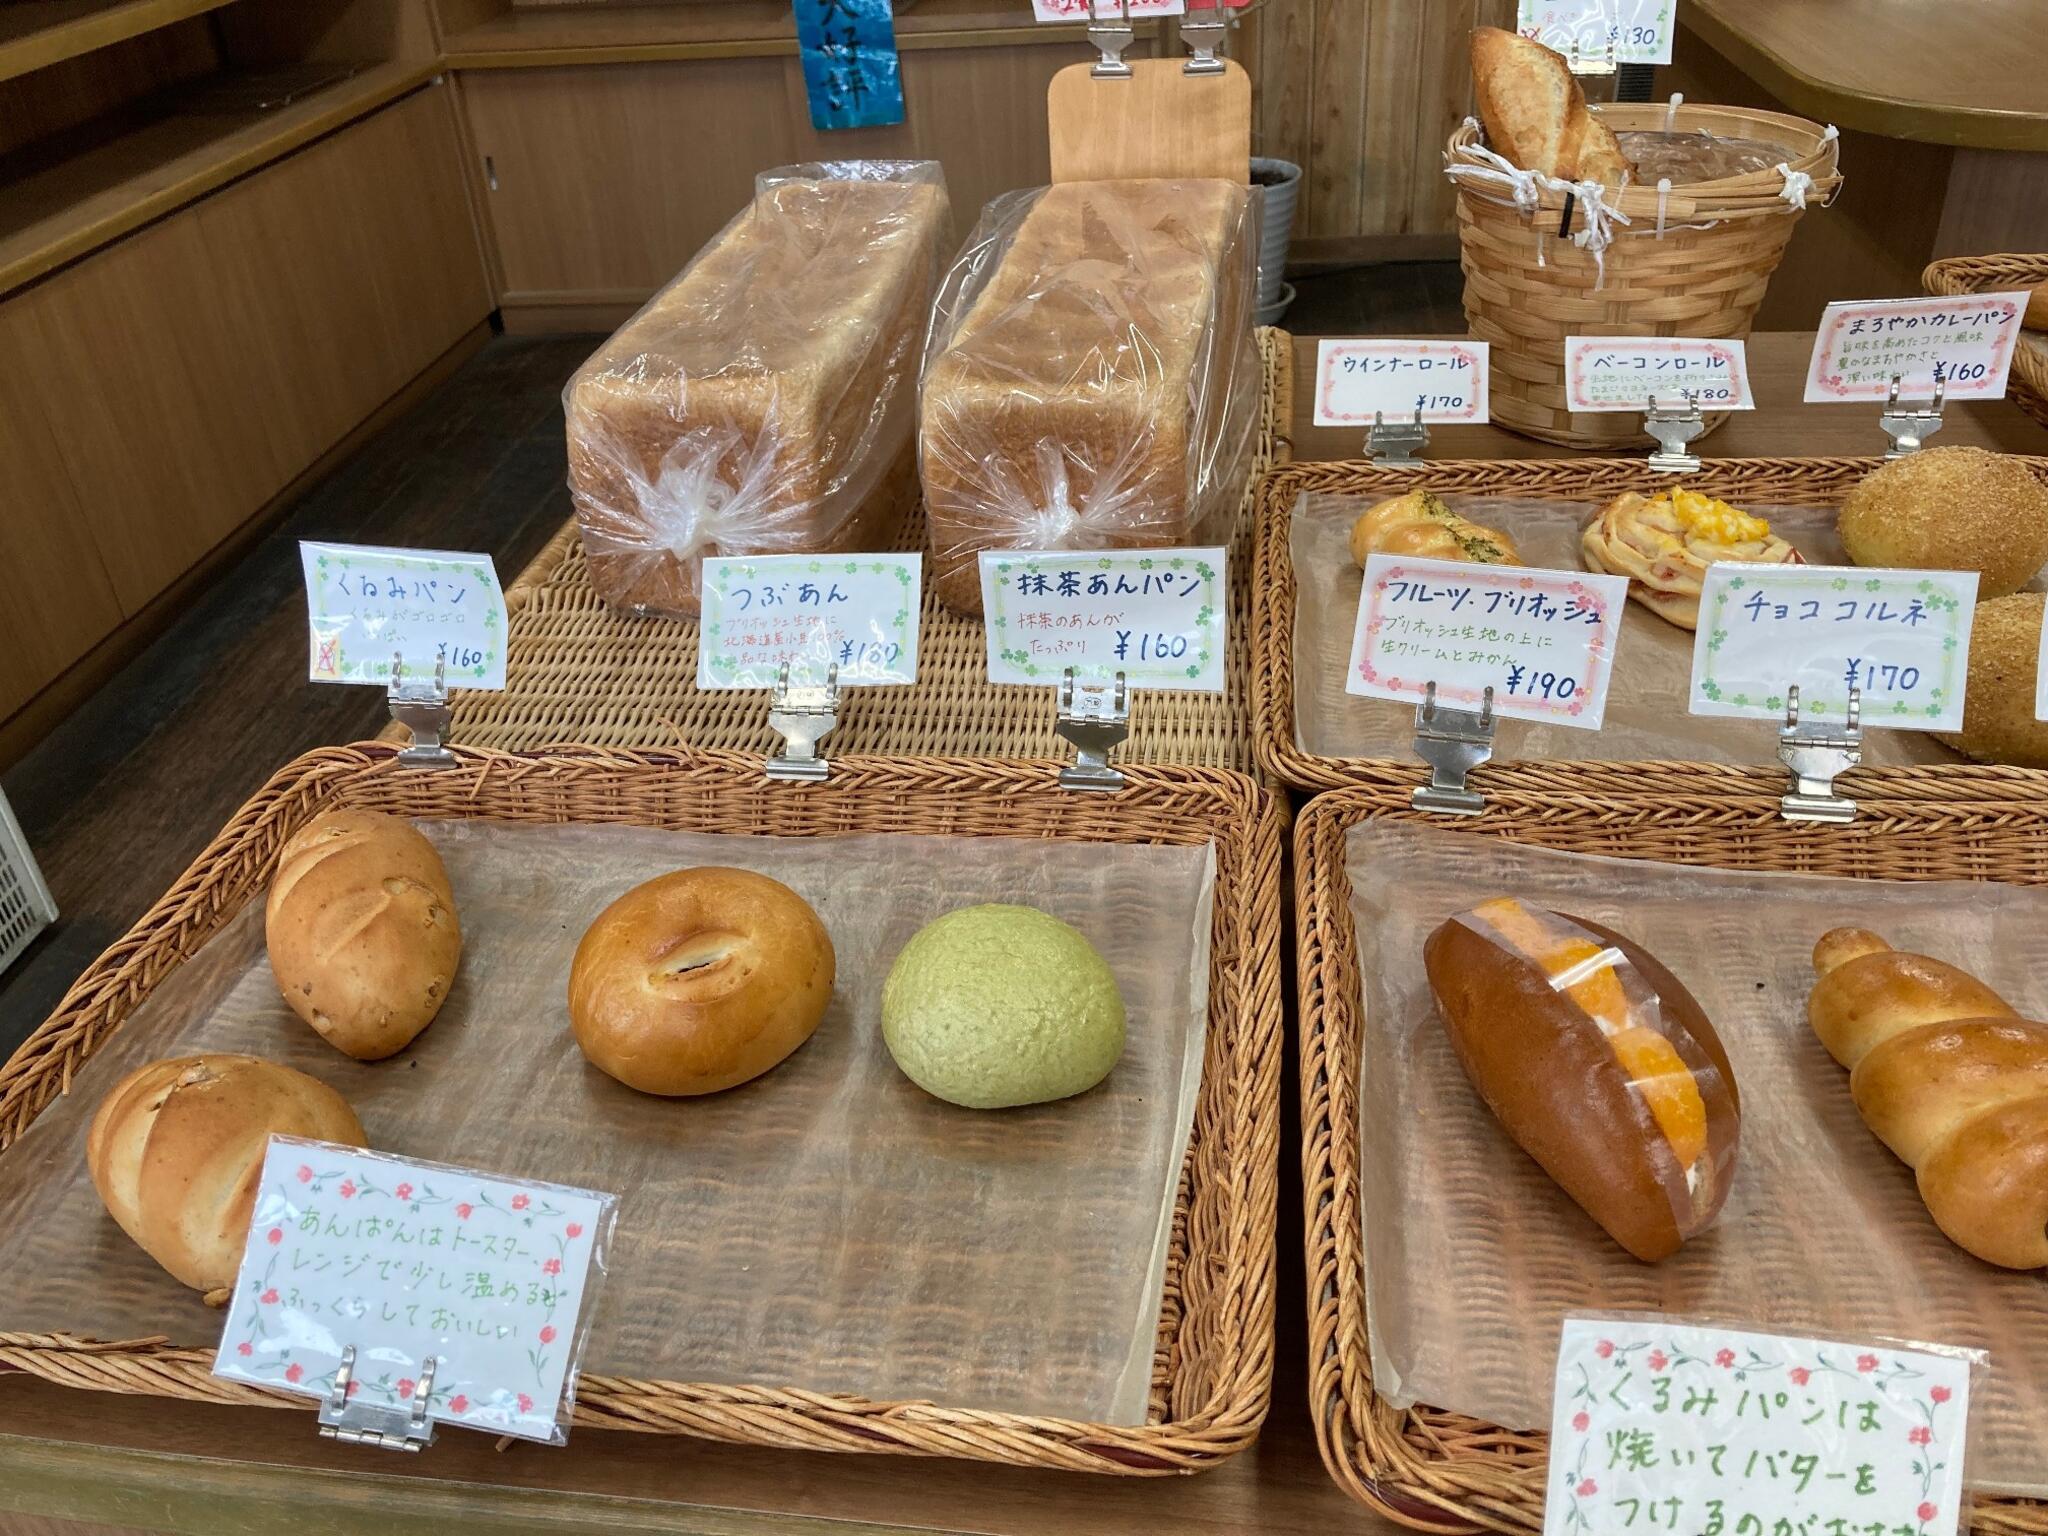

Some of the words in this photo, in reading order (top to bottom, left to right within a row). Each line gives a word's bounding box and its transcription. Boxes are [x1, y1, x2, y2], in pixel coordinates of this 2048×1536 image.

[1849, 310, 2016, 335] まろやかカレーパン
[1594, 354, 1725, 370] ベーコンロール
[1932, 360, 1985, 382] ¥160
[1416, 394, 1463, 411] ¥170
[1680, 387, 1729, 401] ¥180
[339, 572, 466, 604] くるみパン
[731, 582, 848, 610] つぶあん
[1017, 570, 1200, 598] 抹茶あんパン
[1017, 610, 1125, 630] 抹茶のあんが
[1384, 615, 1553, 648] ブリオッシュ生地の上に
[437, 642, 482, 667] ¥160
[1029, 638, 1087, 656] たっぷり
[1113, 630, 1187, 661] ¥160
[1381, 639, 1517, 667] 生クリームとみかん
[1506, 664, 1576, 699] ¥190
[1843, 657, 1920, 691] ¥170
[293, 1248, 560, 1310] レンジで少し温めると
[1608, 1371, 1882, 1432] くるみパンは
[1606, 1427, 1878, 1495] 焼いてバターを
